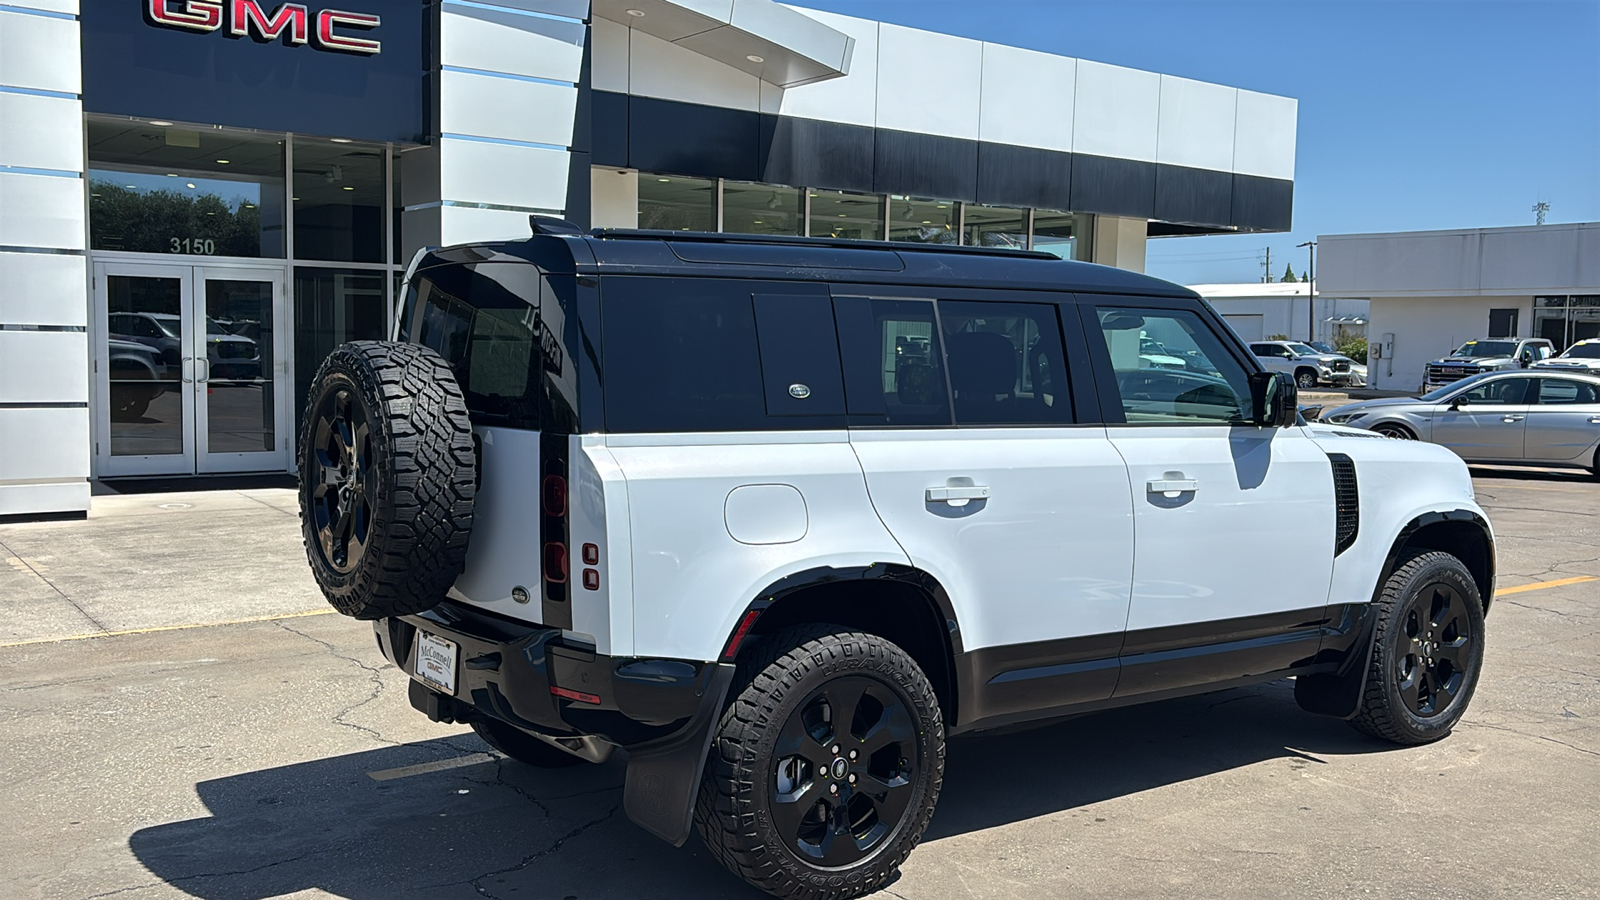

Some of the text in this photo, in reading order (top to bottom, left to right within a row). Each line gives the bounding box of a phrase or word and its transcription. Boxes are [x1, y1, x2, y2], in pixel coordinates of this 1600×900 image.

[150, 0, 381, 54] GMC
[170, 237, 215, 255] 3150
[421, 645, 453, 670] McConnell
[427, 661, 443, 675] GMC
[757, 808, 881, 888] GOODYEAR
